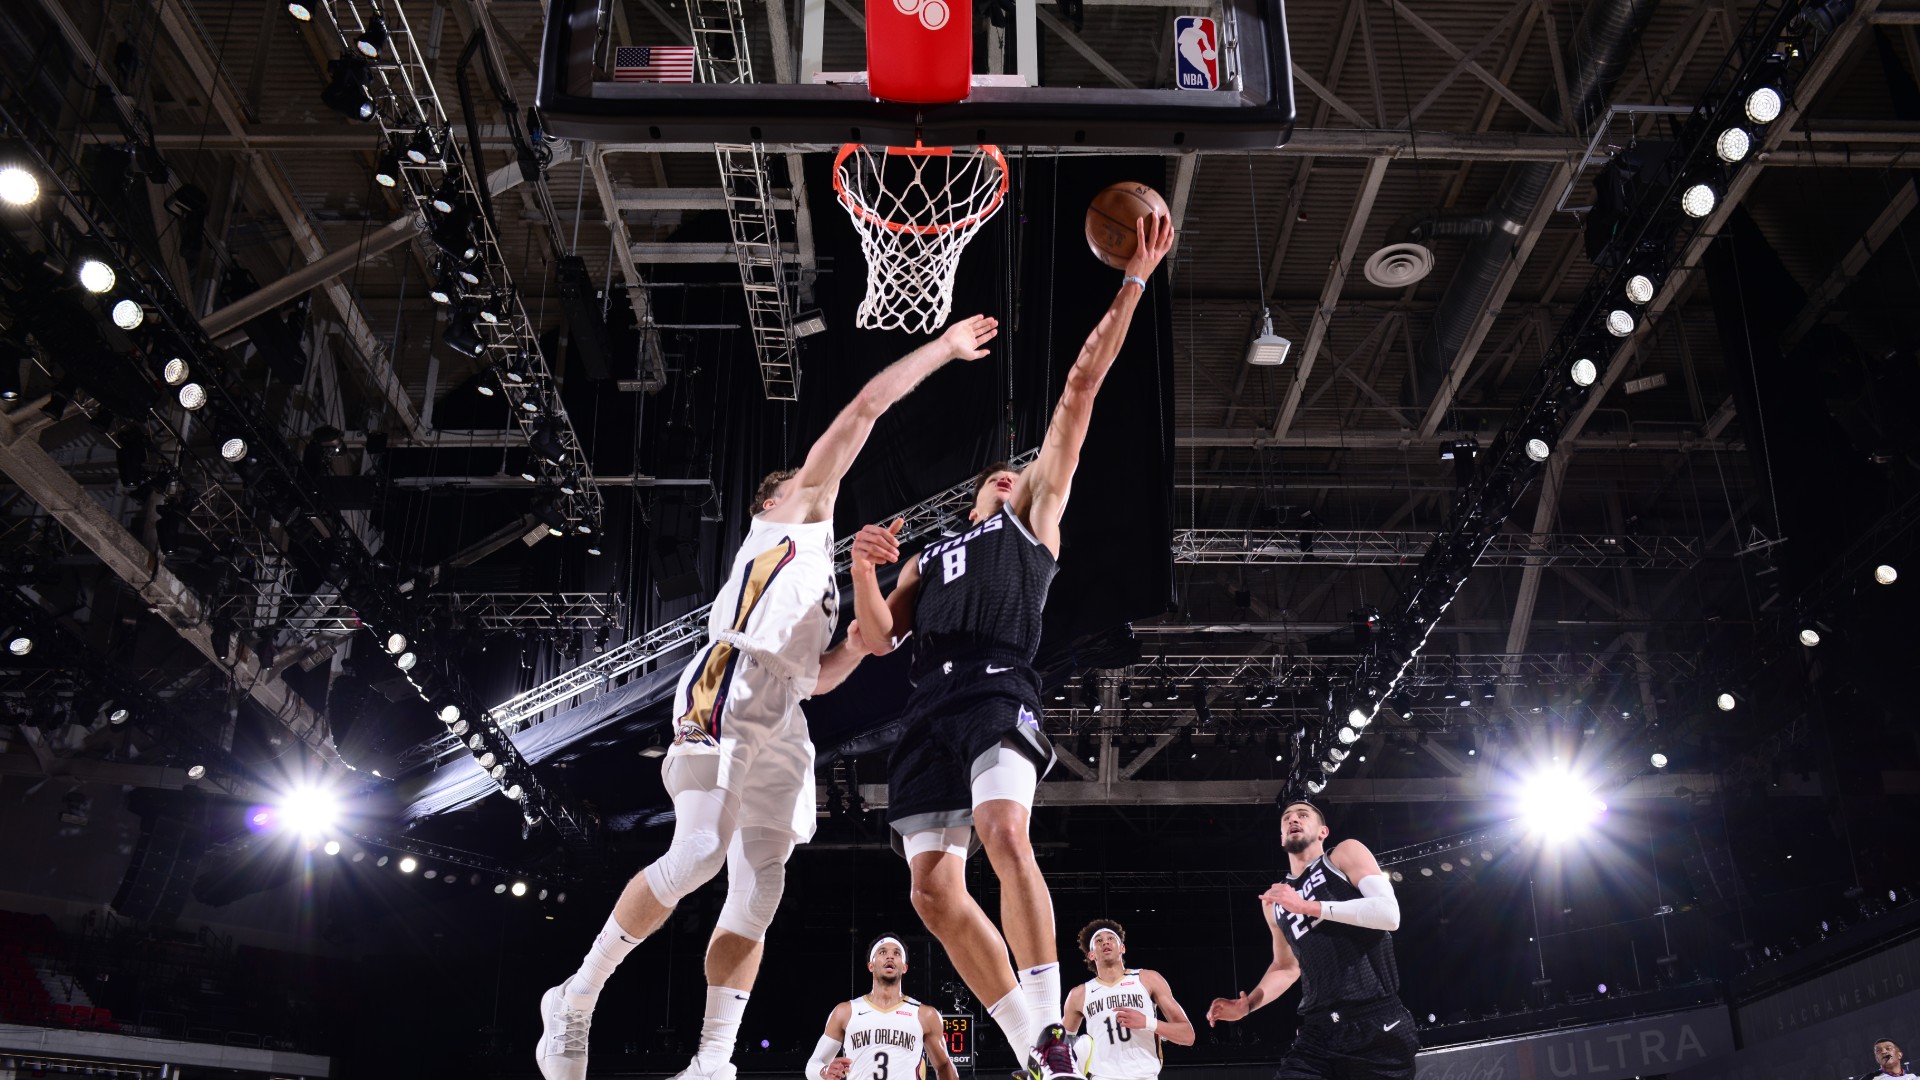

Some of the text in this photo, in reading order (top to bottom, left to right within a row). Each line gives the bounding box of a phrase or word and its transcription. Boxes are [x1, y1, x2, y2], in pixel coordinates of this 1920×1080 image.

[1183, 73, 1204, 86] NBA
[918, 513, 1003, 575] KINGS
[942, 545, 967, 585] 8
[1275, 868, 1327, 920] KGS
[1286, 894, 1326, 940] 2
[1086, 993, 1144, 1019] NEW ORLEANS
[1777, 973, 1905, 1031] SACRAMENTO
[850, 1028, 916, 1052] NEW ORLEANS
[1104, 1016, 1132, 1045] 10
[873, 1051, 889, 1080] 3
[1547, 1024, 1707, 1078] ULTRA
